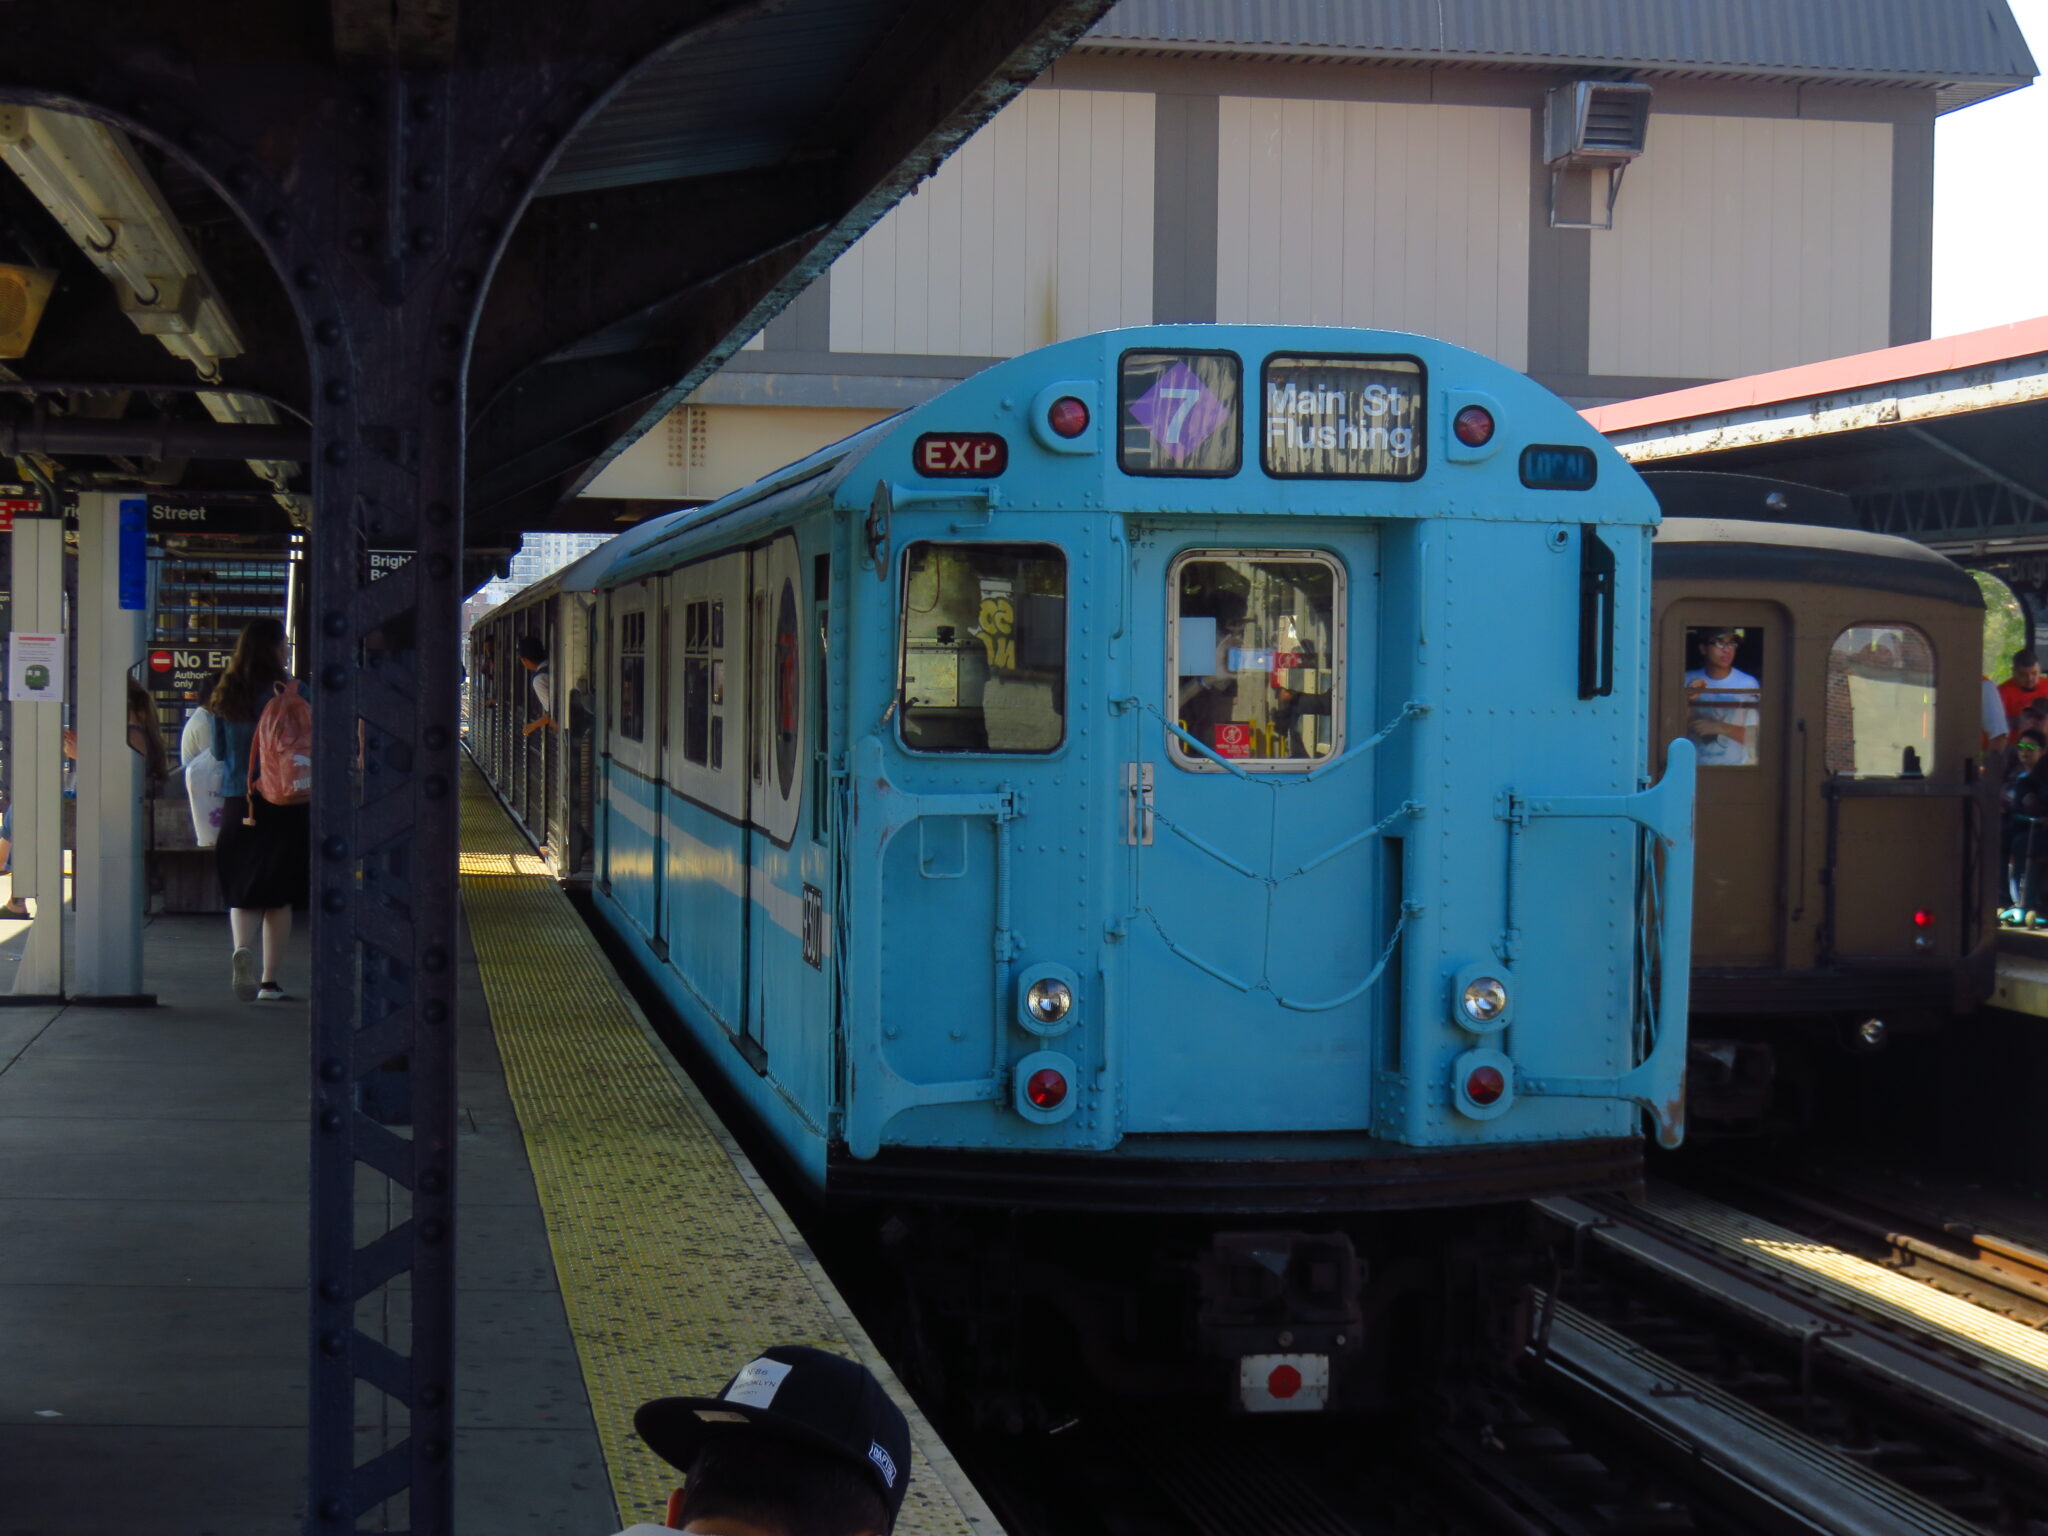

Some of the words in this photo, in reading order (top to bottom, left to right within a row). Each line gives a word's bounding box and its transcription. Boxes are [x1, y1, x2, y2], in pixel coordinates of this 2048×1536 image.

[1267, 382, 1346, 415] Main
[1362, 383, 1402, 417] St
[1159, 387, 1201, 444] 7
[1267, 416, 1413, 458] Flushing
[925, 440, 997, 469] EXP
[152, 504, 207, 520] Street
[173, 651, 201, 668] No
[174, 681, 193, 690] only
